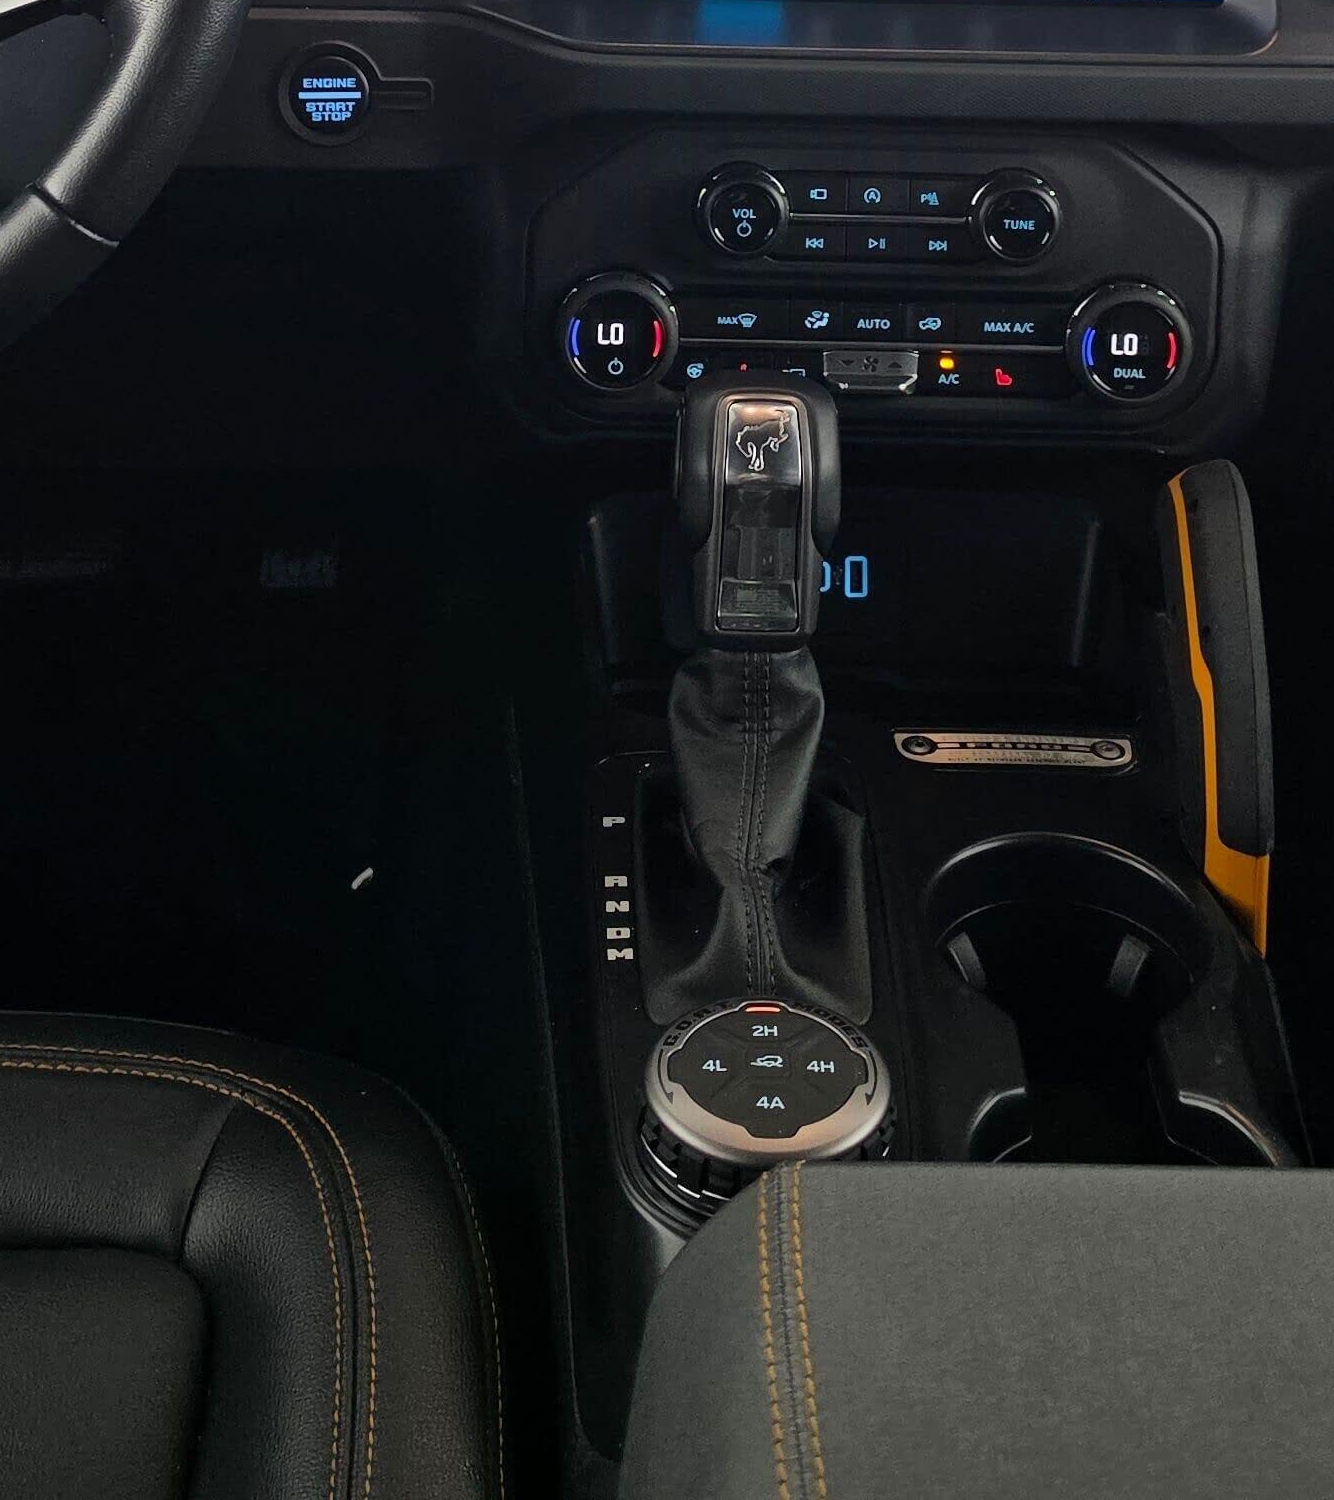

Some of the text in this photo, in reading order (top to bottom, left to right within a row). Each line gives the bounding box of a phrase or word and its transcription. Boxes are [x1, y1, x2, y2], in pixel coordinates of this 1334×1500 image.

[302, 78, 357, 89] ENGINE
[305, 102, 356, 112] START
[311, 111, 352, 122] STOP
[732, 208, 757, 219] VOL
[1004, 219, 1036, 231] TUNE
[717, 316, 739, 325] MAX
[856, 318, 891, 330] AUTO
[983, 321, 1035, 333] MAX A/C
[597, 322, 625, 346] LO
[1110, 332, 1139, 356] LO
[938, 373, 960, 385] A/C
[1113, 368, 1147, 379] DUAL
[602, 816, 626, 828] P
[604, 875, 628, 888] R
[605, 900, 630, 913] N
[606, 927, 631, 939] D
[607, 948, 634, 961] M
[752, 1024, 778, 1037] 2H
[702, 1059, 727, 1072] 4L
[806, 1060, 835, 1073] 4H
[755, 1096, 785, 1110] 4A
